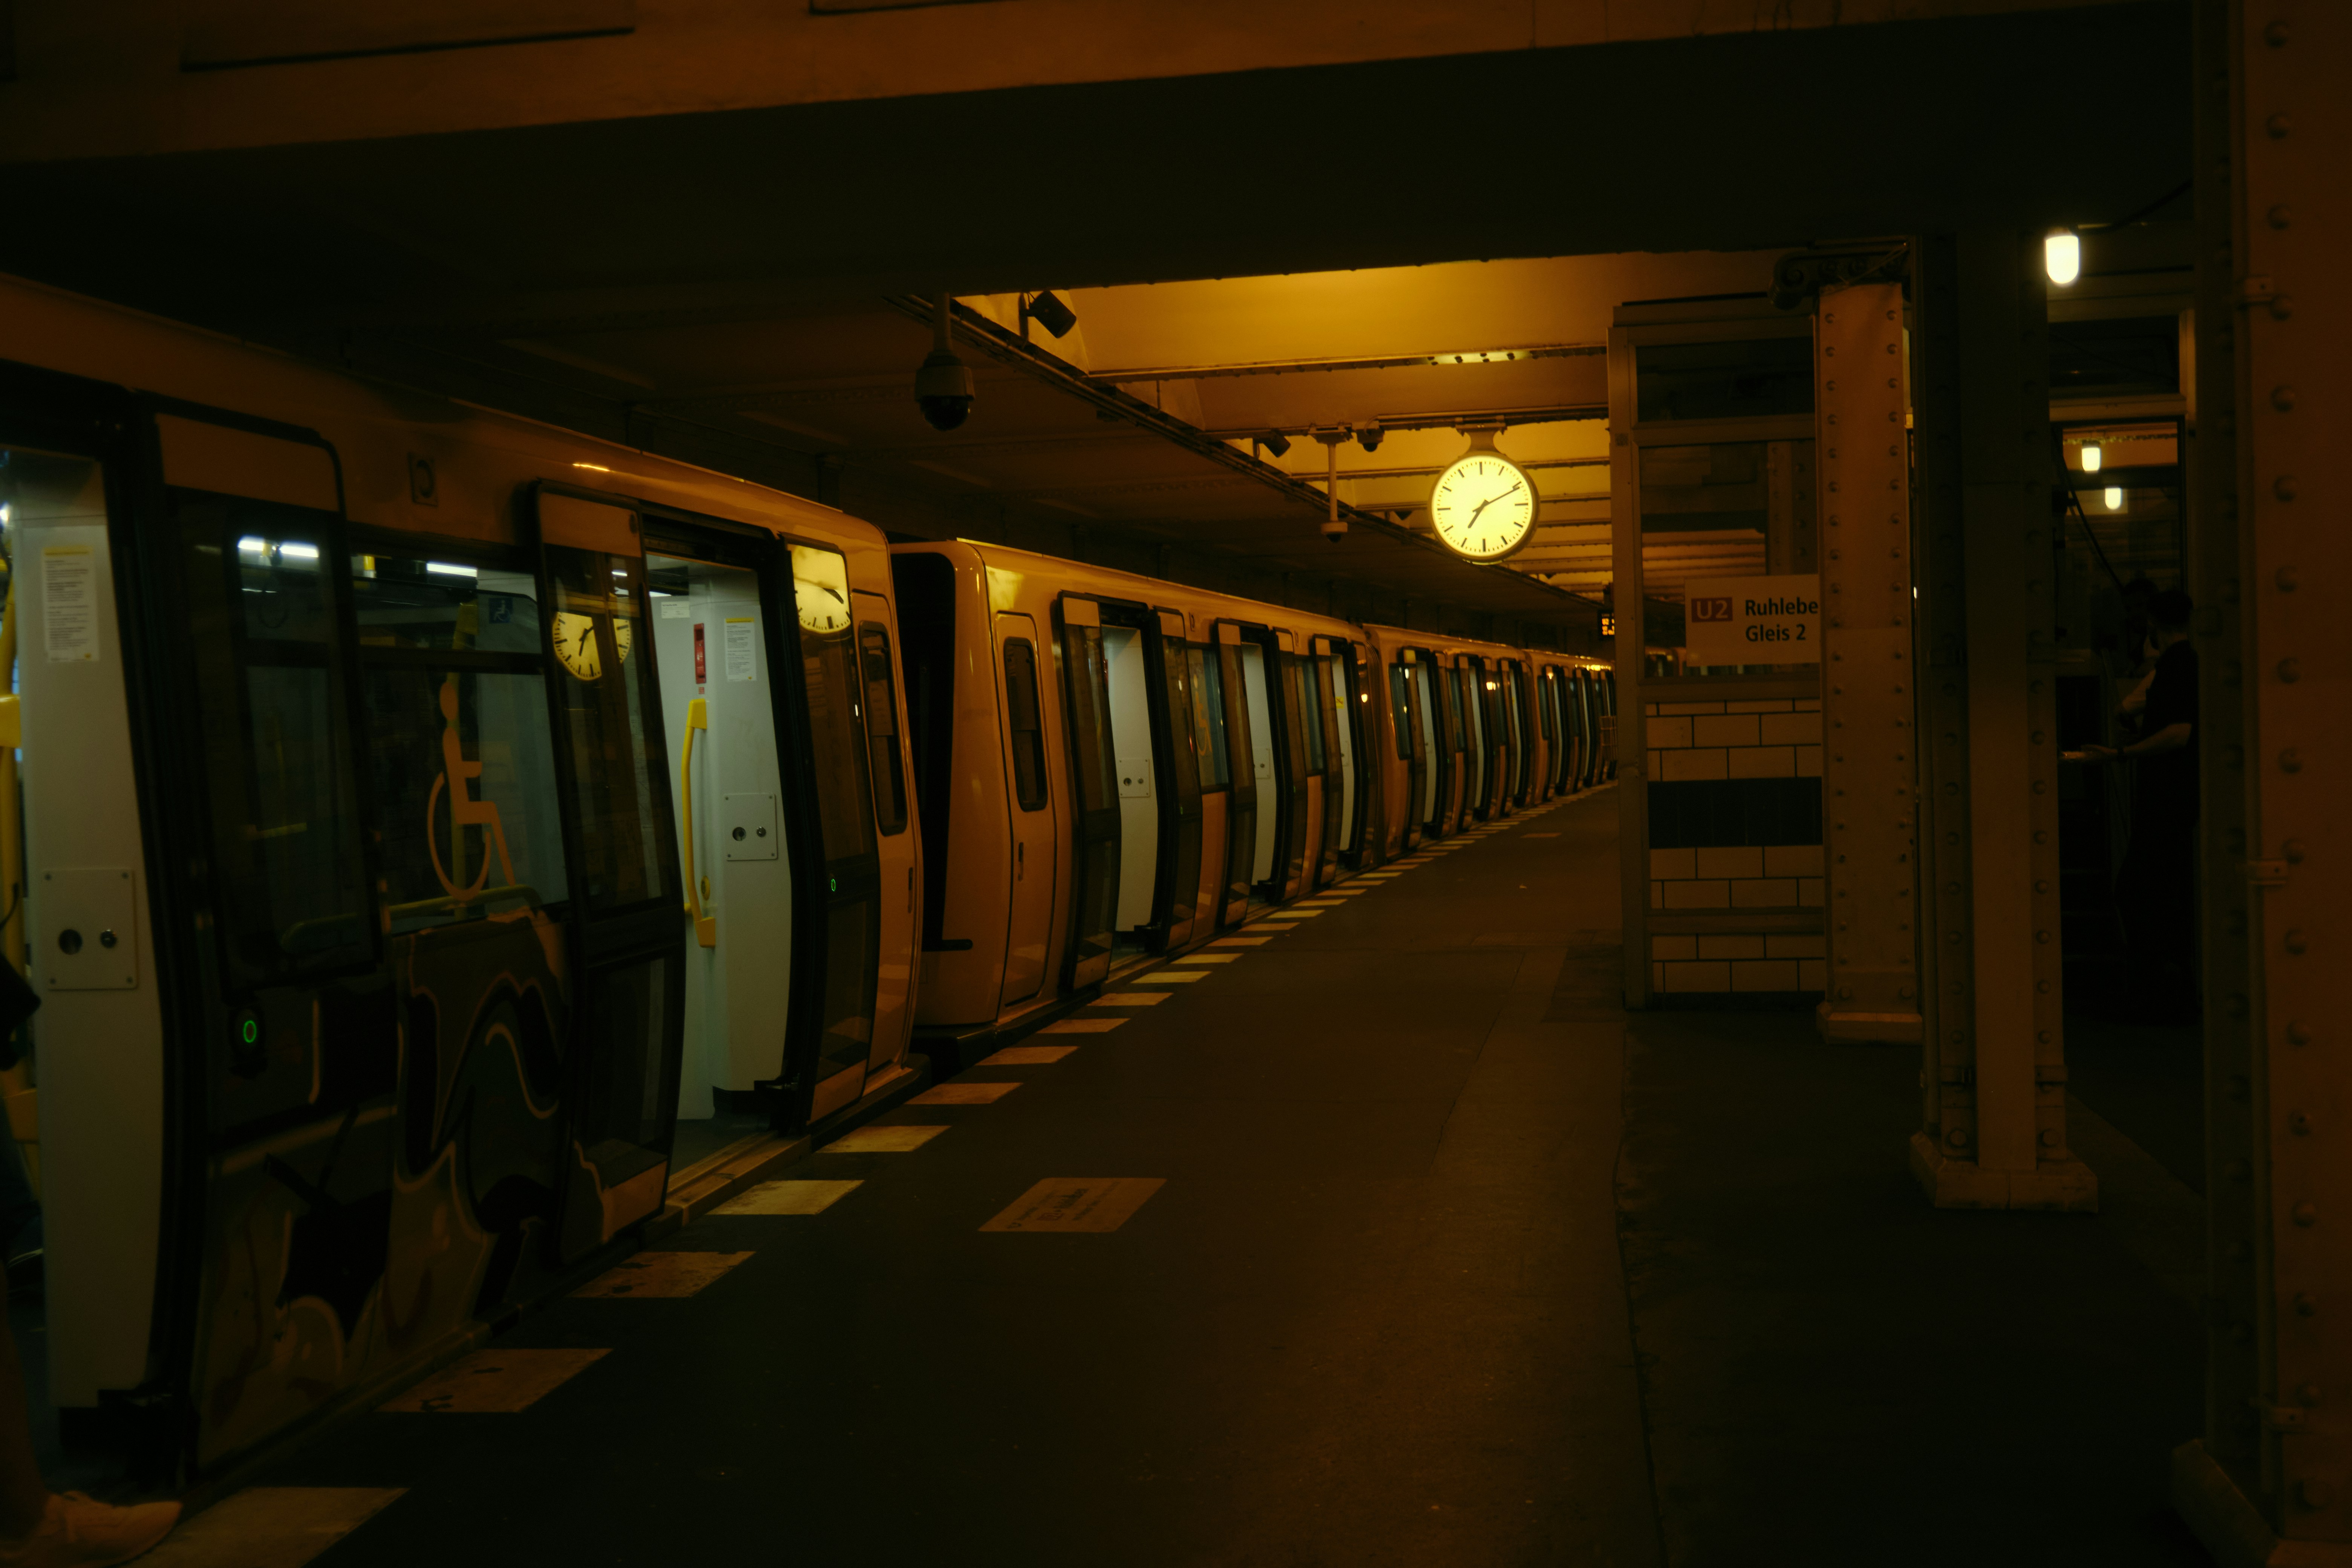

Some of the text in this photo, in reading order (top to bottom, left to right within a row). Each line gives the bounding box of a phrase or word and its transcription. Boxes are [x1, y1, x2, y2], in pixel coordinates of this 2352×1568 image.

[1697, 597, 1818, 619] U2 Ruhlebe
[1746, 623, 1806, 642] Gleis 2
